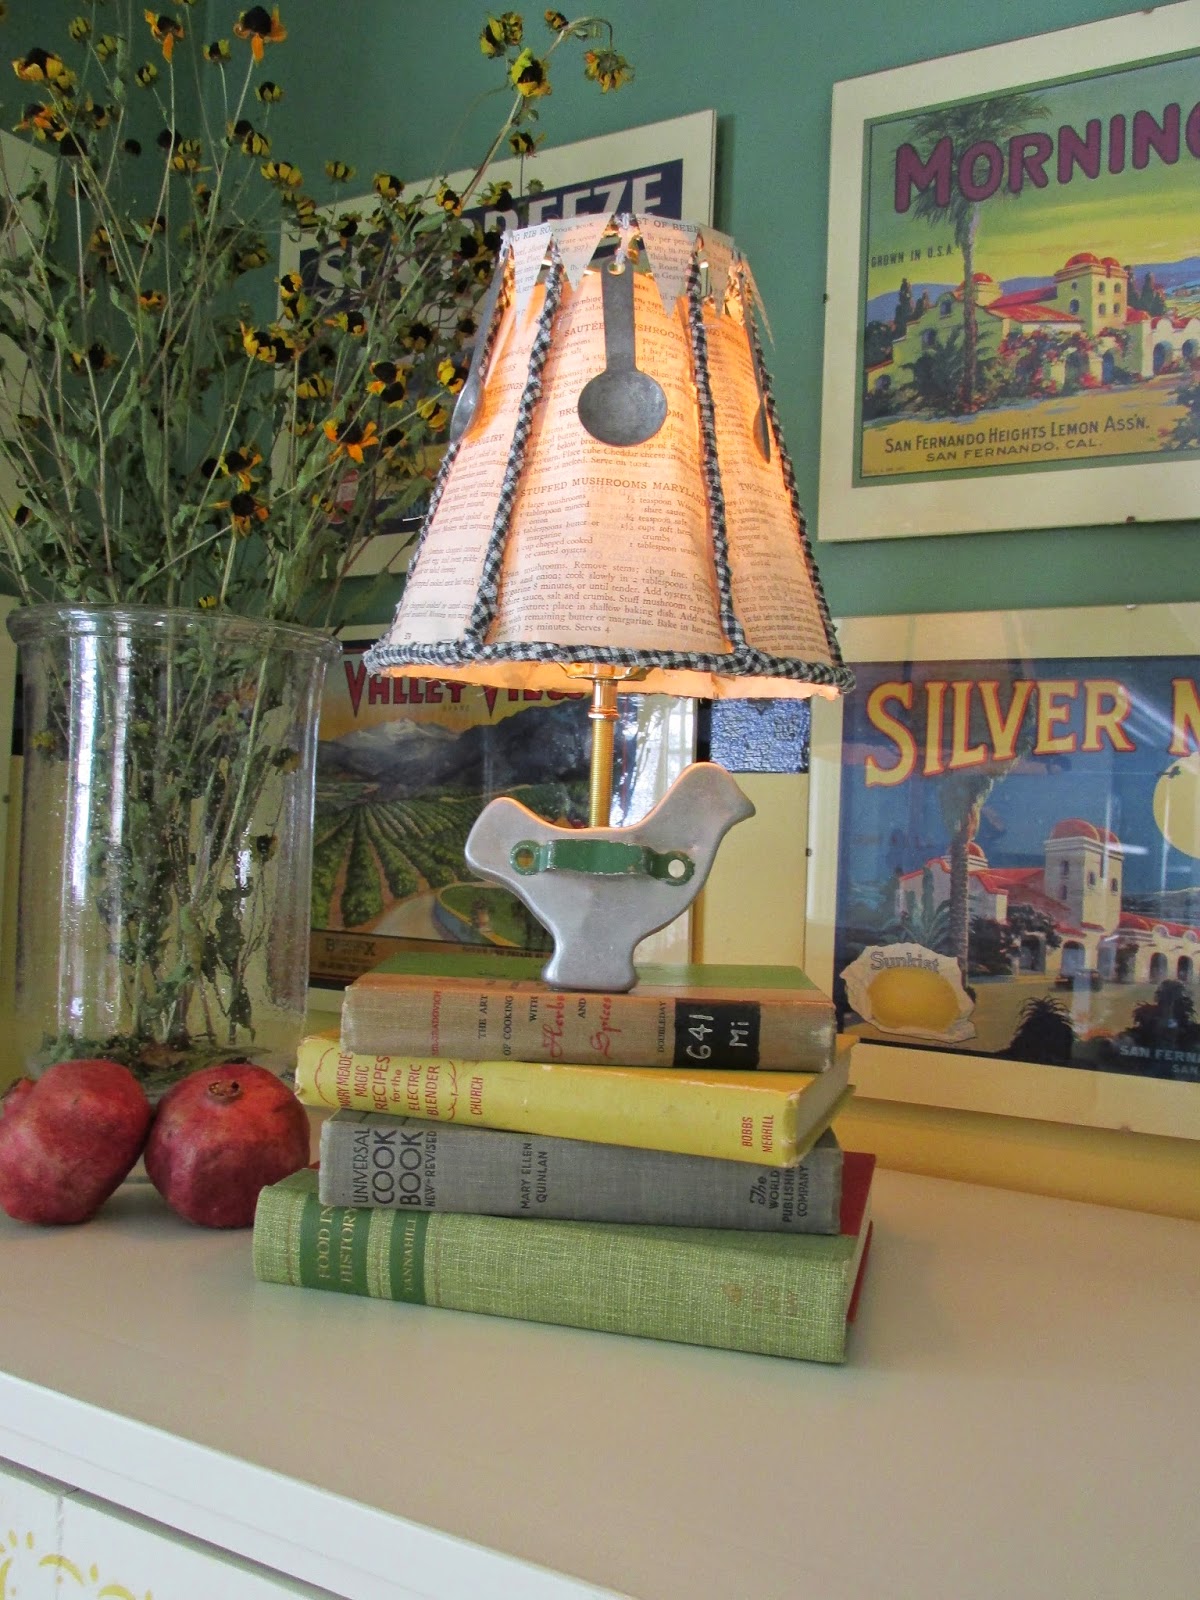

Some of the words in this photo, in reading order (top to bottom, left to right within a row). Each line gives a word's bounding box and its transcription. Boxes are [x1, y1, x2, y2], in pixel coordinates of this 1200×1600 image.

[653, 220, 668, 229] OF
[916, 431, 985, 450] FERNANDO
[989, 425, 1047, 442] HEIGHTS
[1051, 420, 1099, 439] LEMON
[926, 452, 957, 463] SAN
[520, 481, 568, 497] STUFFED
[572, 477, 647, 490] MUSHROOMS
[566, 536, 594, 545] cooked
[565, 570, 585, 580] cook
[588, 571, 616, 583] slowly
[619, 574, 629, 583] in
[641, 576, 689, 590] tablespoons
[573, 560, 608, 570] Remove
[645, 565, 666, 577] chop
[540, 582, 575, 591] minutes,
[589, 582, 610, 590] until
[612, 585, 641, 594] tender.
[642, 586, 662, 596] Add
[547, 592, 561, 600] salt
[564, 592, 580, 600] and
[583, 593, 616, 602] crumbs.
[618, 594, 640, 604] Stuff
[642, 597, 687, 611] mushroom
[524, 612, 566, 622] remaining
[568, 611, 595, 621] butter
[608, 615, 655, 627] margarine.
[657, 618, 678, 630] Bake
[680, 621, 689, 631] in
[692, 625, 704, 635] hot
[552, 602, 574, 612] place
[576, 602, 586, 611] in
[589, 602, 621, 612] shallow
[624, 604, 654, 618] baking
[656, 607, 677, 619] dish.
[679, 612, 698, 621] Add
[536, 623, 572, 632] minutes.
[574, 623, 602, 632] Serves
[864, 678, 1137, 788] SILVER
[870, 951, 940, 972] Sunkist
[479, 994, 489, 1015] ART
[503, 995, 514, 1040] COOKING
[529, 995, 539, 1022] WITH
[577, 997, 588, 1019] AND
[478, 1017, 487, 1040] THE
[686, 1013, 715, 1060] 641
[728, 1021, 750, 1047] Mi
[502, 1045, 512, 1056] OF
[1155, 1048, 1200, 1064] FERN
[354, 1065, 370, 1098] MAGIC
[371, 1055, 391, 1112] RECIPES
[407, 1063, 423, 1112] ELECTRIC
[425, 1064, 441, 1117] BLENDER
[469, 1076, 484, 1116] CHURCH
[741, 1115, 754, 1148] BOBBS
[761, 1114, 775, 1153] MERRILL
[352, 1127, 370, 1203] UNIVERSAL
[372, 1129, 398, 1205] COOK
[399, 1130, 424, 1206] BOOK
[521, 1142, 533, 1175] ELLEN
[535, 1150, 549, 1203] QUINLAN
[768, 1169, 782, 1209] WORLD
[797, 1164, 809, 1217] COMPANY
[520, 1179, 532, 1210] MARY
[782, 1165, 796, 1223] PUBLISHIN
[317, 1228, 331, 1279] FOOD
[340, 1206, 359, 1282] HISTORY
